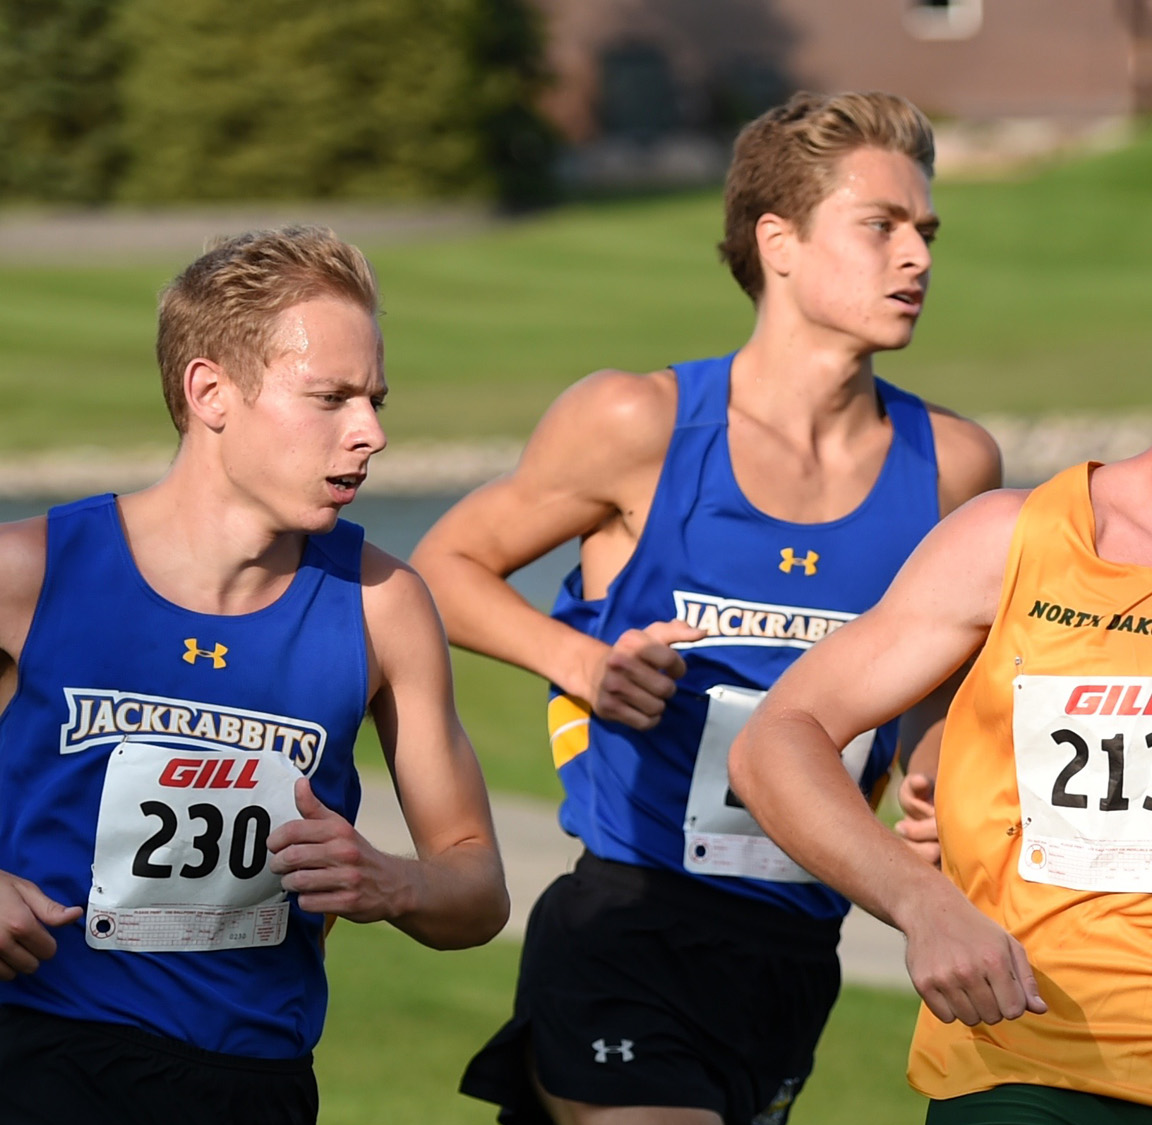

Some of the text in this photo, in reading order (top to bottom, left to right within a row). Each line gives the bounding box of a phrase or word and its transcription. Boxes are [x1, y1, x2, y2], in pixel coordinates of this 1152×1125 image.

[72, 699, 317, 770] JACKRABBITS
[158, 759, 260, 789] GILL
[132, 800, 271, 880] 230
